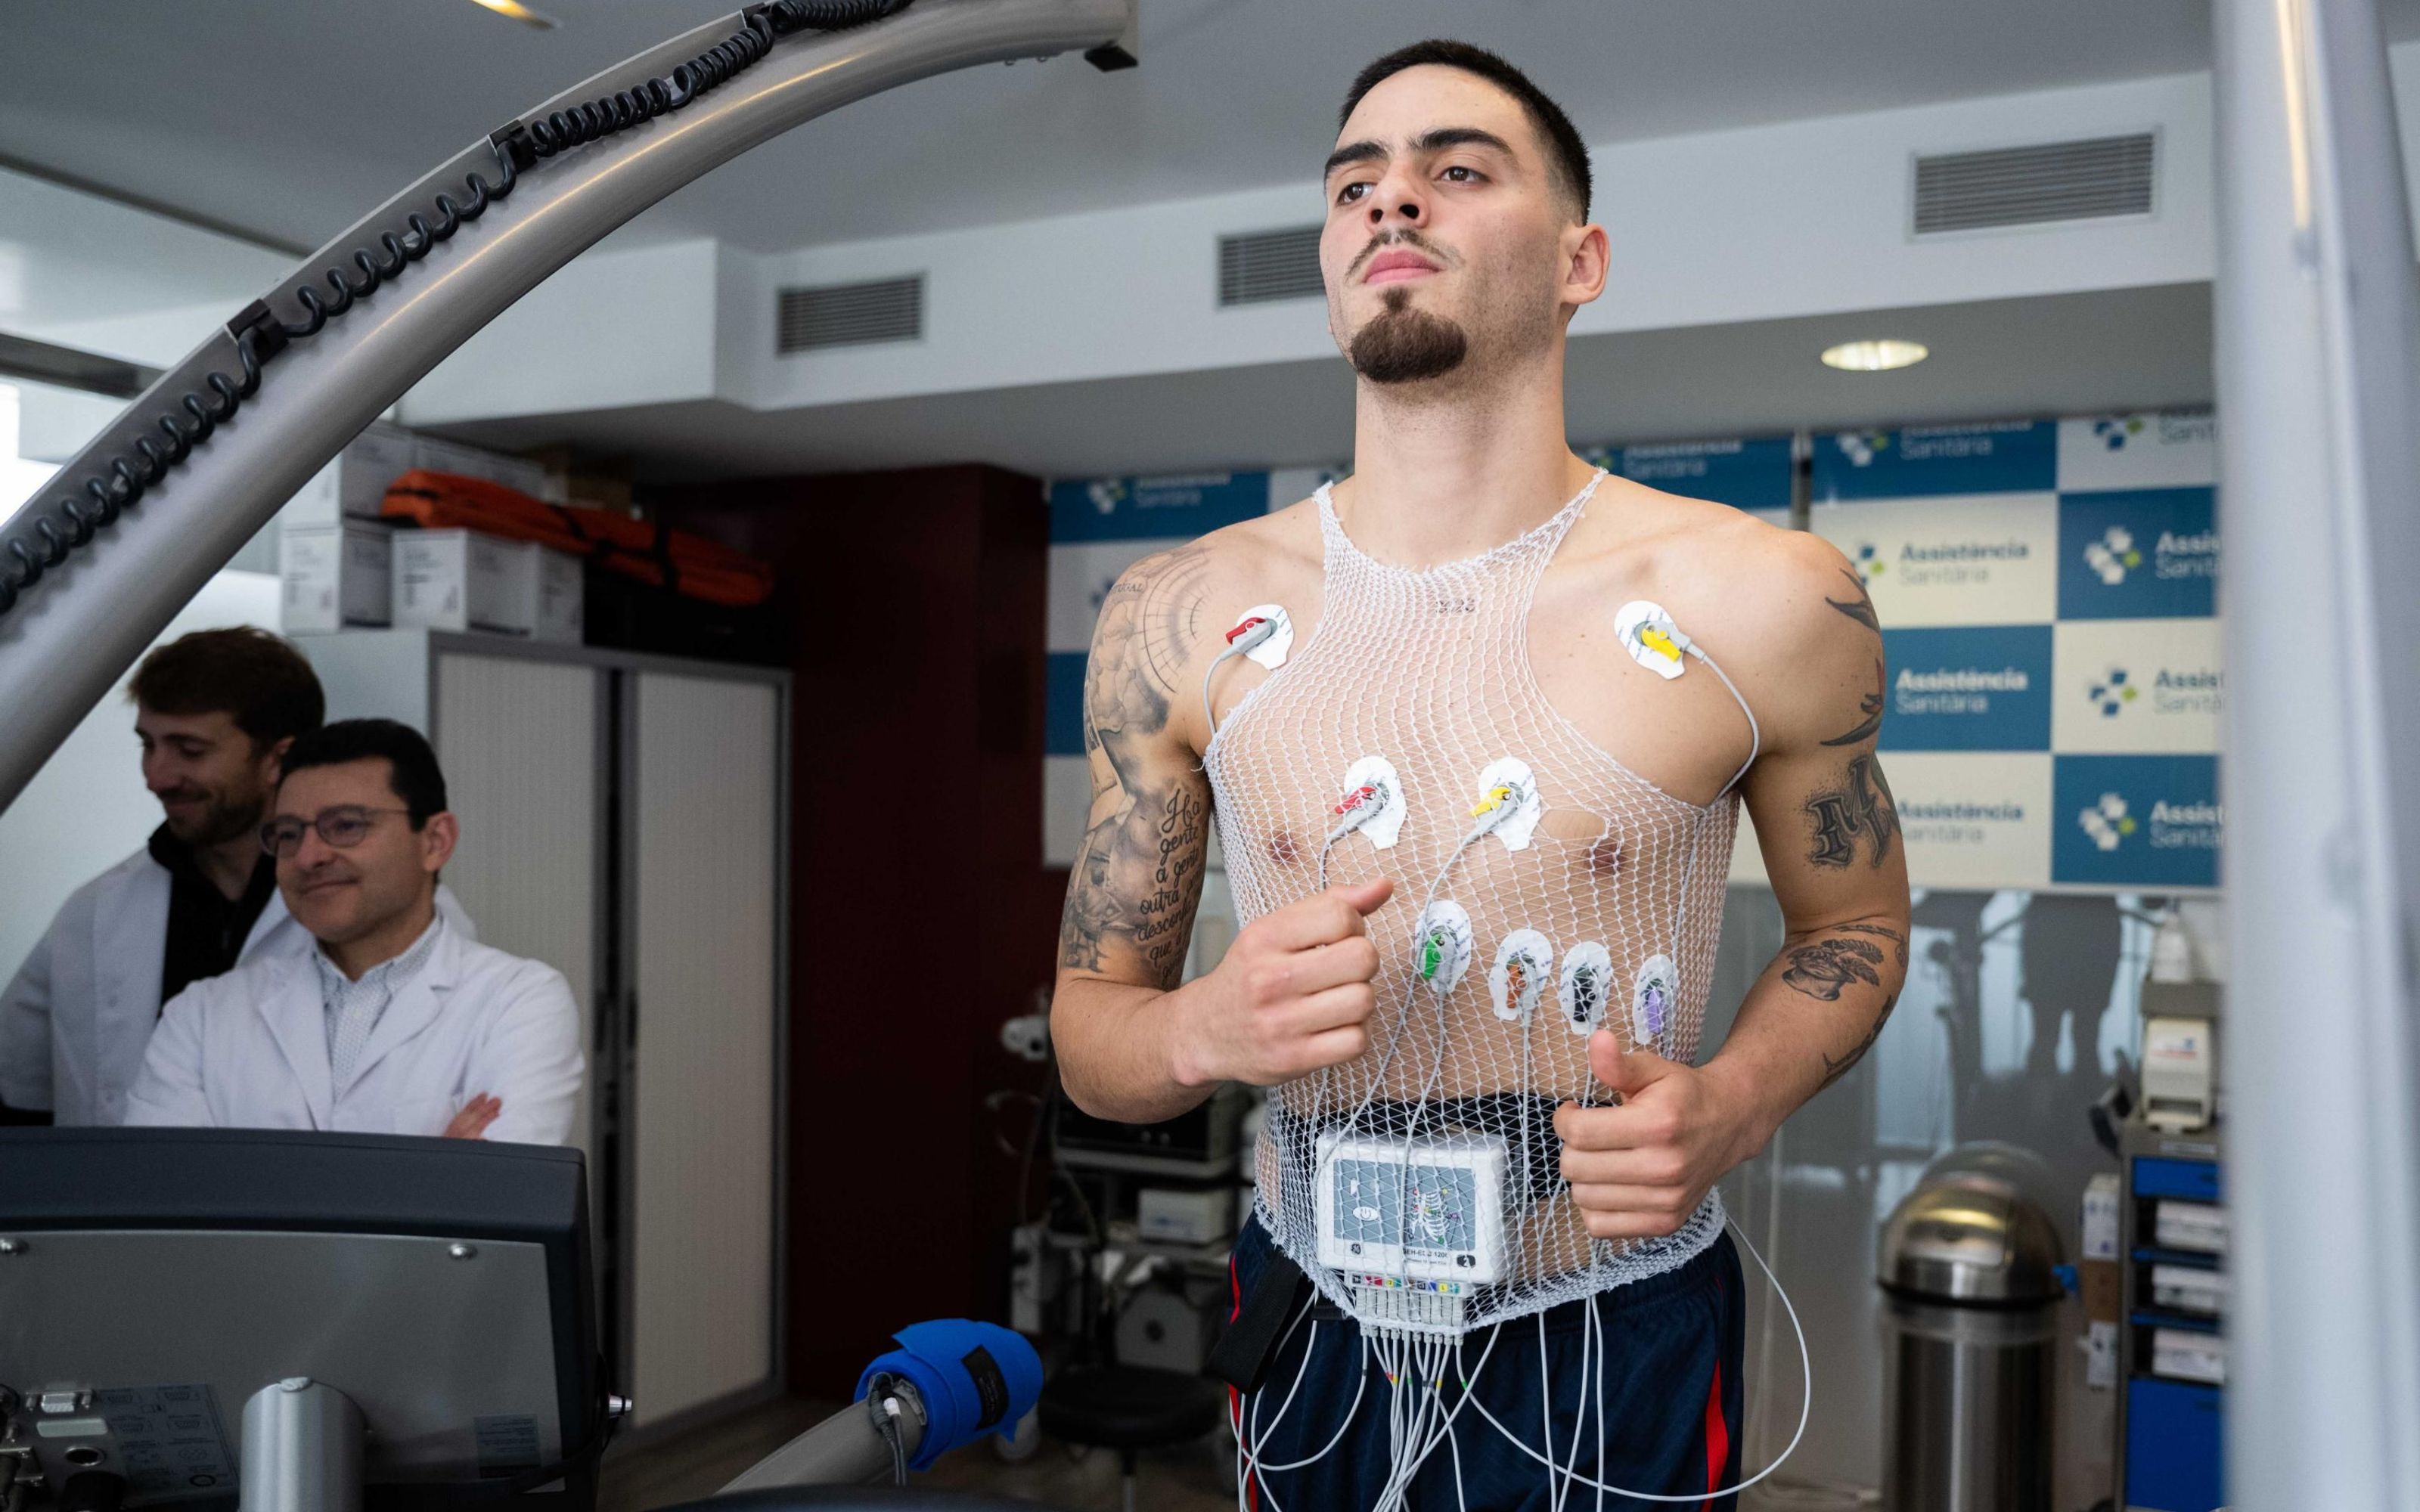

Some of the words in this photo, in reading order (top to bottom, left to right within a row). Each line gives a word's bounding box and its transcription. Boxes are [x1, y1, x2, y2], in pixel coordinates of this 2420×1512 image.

[1900, 538, 2030, 562] Assistència
[1896, 667, 2028, 692] Assistència
[1903, 825, 1984, 844] anitària
[1140, 887, 1180, 915] outra
